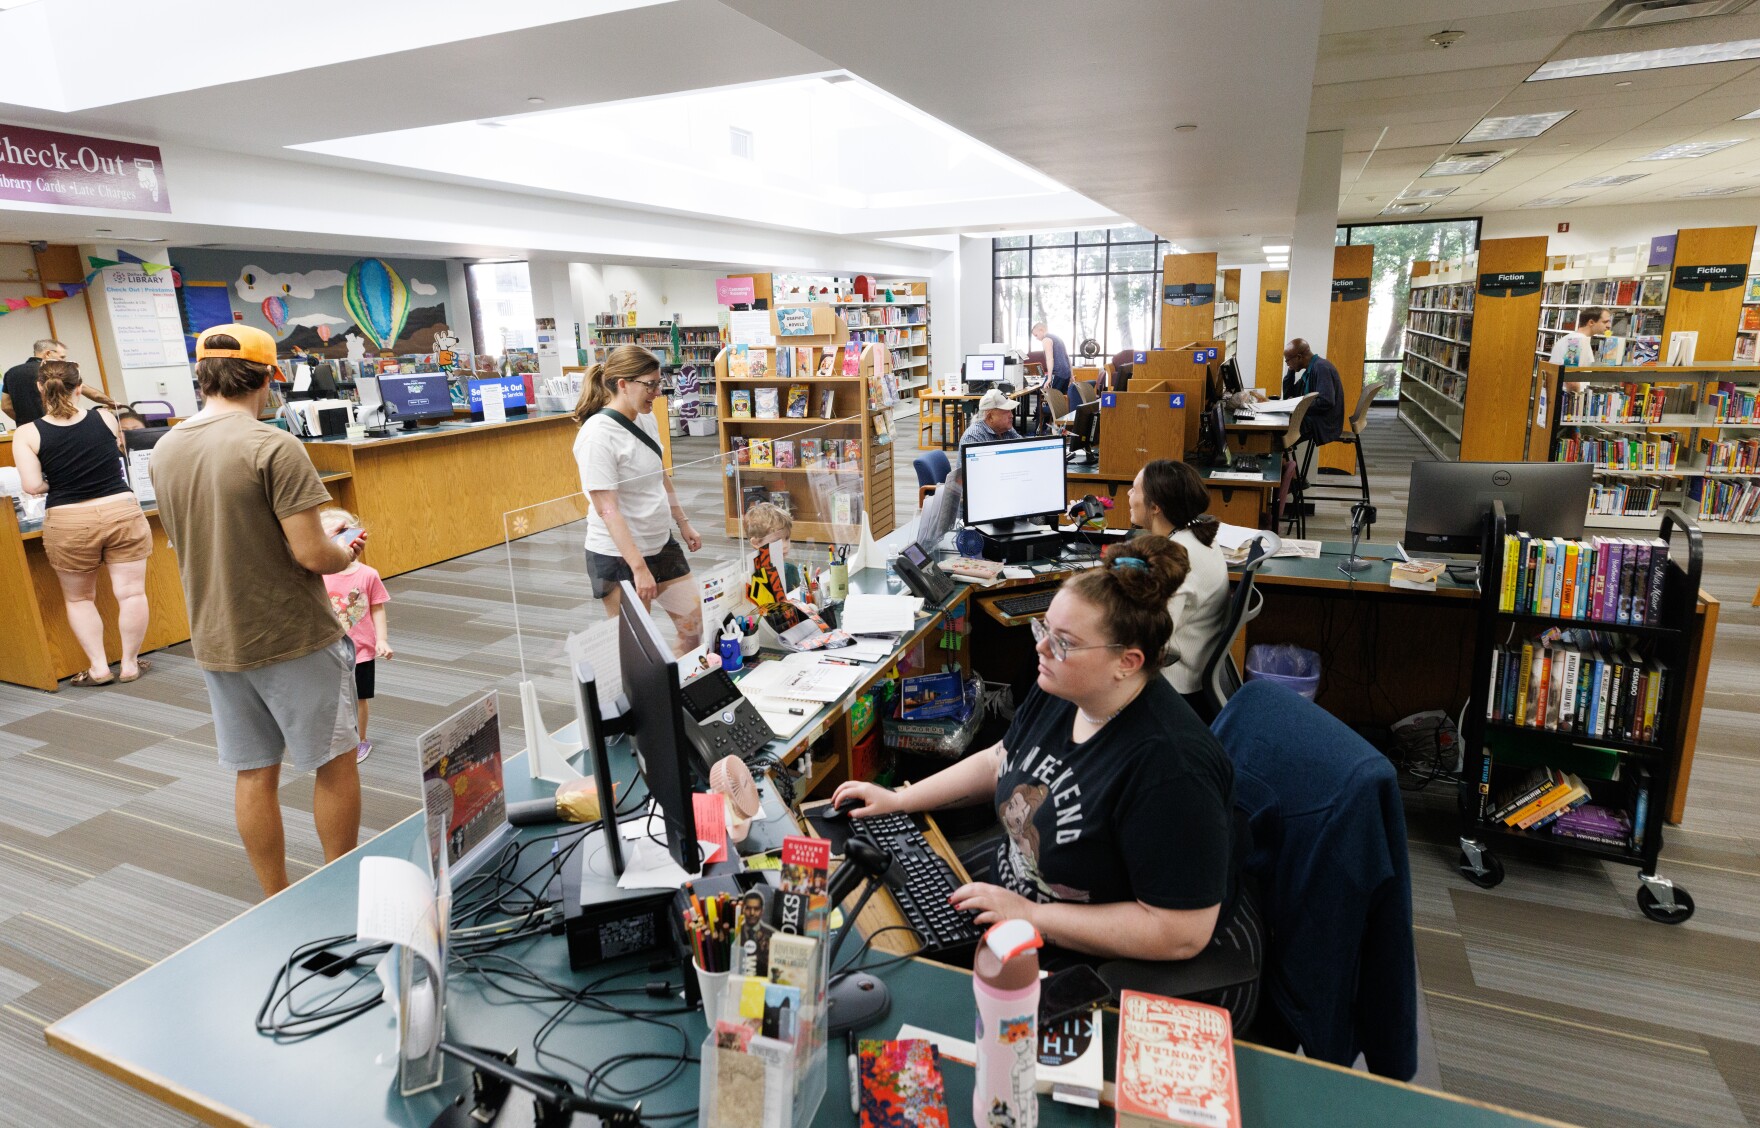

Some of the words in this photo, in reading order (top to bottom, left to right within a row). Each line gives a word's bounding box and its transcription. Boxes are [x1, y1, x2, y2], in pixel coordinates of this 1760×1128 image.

[0, 174, 32, 192] ibrary
[36, 178, 66, 194] Cards
[98, 185, 136, 201] Charges
[1136, 354, 1143, 362] 2
[1197, 353, 1204, 362] 5
[1105, 396, 1111, 405] 1
[1172, 396, 1181, 406] 4
[1596, 575, 1605, 596] PET
[1650, 585, 1661, 610] Meteor
[1568, 655, 1576, 672] AMERICAN
[1631, 667, 1640, 696] DESNUDO
[1576, 834, 1600, 842] GRAHAM
[1601, 838, 1626, 846] HEATHER
[788, 843, 823, 853] CULTURE
[796, 849, 815, 857] PASS
[791, 854, 819, 864] DALLAS
[1144, 1044, 1206, 1062] AVONLEA
[1170, 1060, 1182, 1068] of
[1154, 1066, 1196, 1081] ANNE
